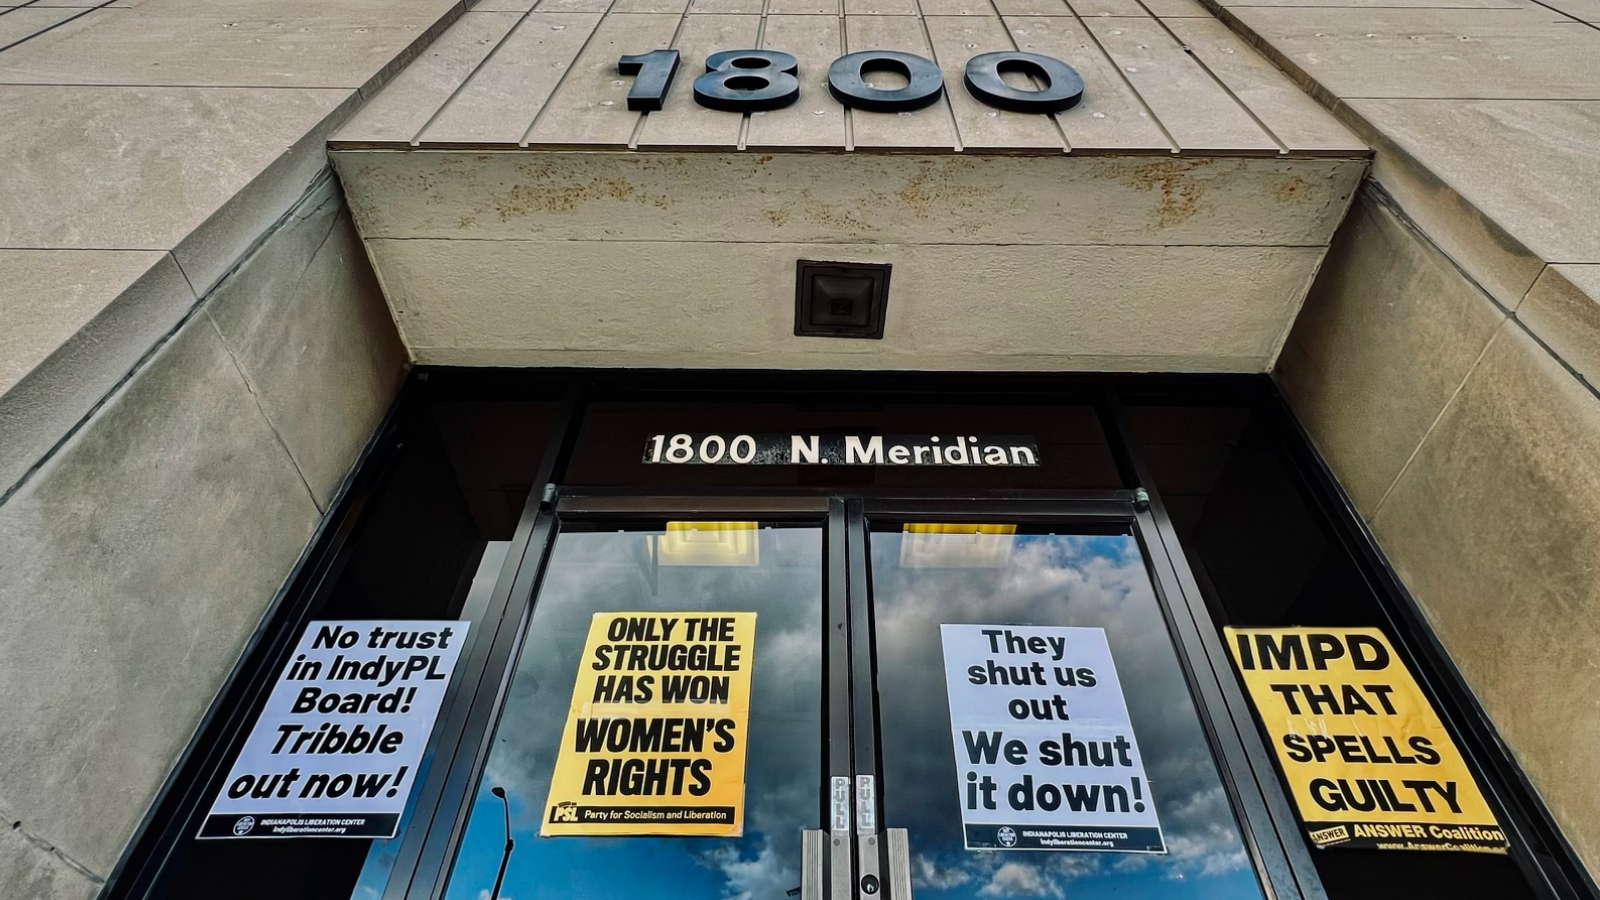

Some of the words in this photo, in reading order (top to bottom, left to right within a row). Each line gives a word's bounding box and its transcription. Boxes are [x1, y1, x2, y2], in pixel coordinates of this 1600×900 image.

[618, 48, 1085, 113] 1800
[651, 433, 757, 464] 1800
[790, 435, 828, 464] N.
[844, 435, 1038, 465] Meridian
[311, 625, 360, 650] No
[367, 626, 453, 650] trust
[607, 617, 679, 642] ONLY
[684, 617, 736, 642] THE
[981, 629, 1066, 661] They
[592, 644, 742, 672] STRUGGLE
[1235, 633, 1390, 671] IMPD
[286, 654, 322, 681] in
[327, 655, 447, 688] IndyPL
[967, 660, 1047, 686] shut
[1054, 666, 1097, 687] us
[290, 687, 418, 714] Board!
[592, 675, 655, 704] HAS
[661, 675, 730, 704] WON
[1269, 684, 1398, 715] THAT
[1008, 694, 1070, 721] out
[271, 722, 404, 754] Tribble
[574, 717, 736, 754] WOMEN'S
[962, 730, 1028, 766] We
[1038, 732, 1133, 767] shut
[1282, 734, 1441, 765] SPELLS
[227, 768, 300, 799] out
[298, 766, 409, 799] now!
[581, 758, 713, 797] RIGHTS
[966, 771, 997, 810] it
[1007, 774, 1146, 813] down!
[835, 778, 846, 830] PULL
[860, 776, 871, 827] PULL
[1309, 778, 1463, 814] GUILTY
[260, 818, 304, 826] INDIANAPOLIS
[304, 818, 341, 826] LIBERATION
[341, 818, 366, 826] CENTER
[553, 806, 579, 822] PSL
[584, 809, 608, 821] Party
[609, 809, 623, 820] for
[624, 809, 665, 820] Socialism
[666, 810, 682, 820] and
[683, 810, 727, 820] Liberation
[1022, 830, 1066, 838] INDIANAPOLIS
[1066, 831, 1103, 839] LIBERATION
[1312, 828, 1346, 842] ANSWER
[1353, 823, 1428, 839] ANSWER
[1429, 825, 1505, 841] Coalition
